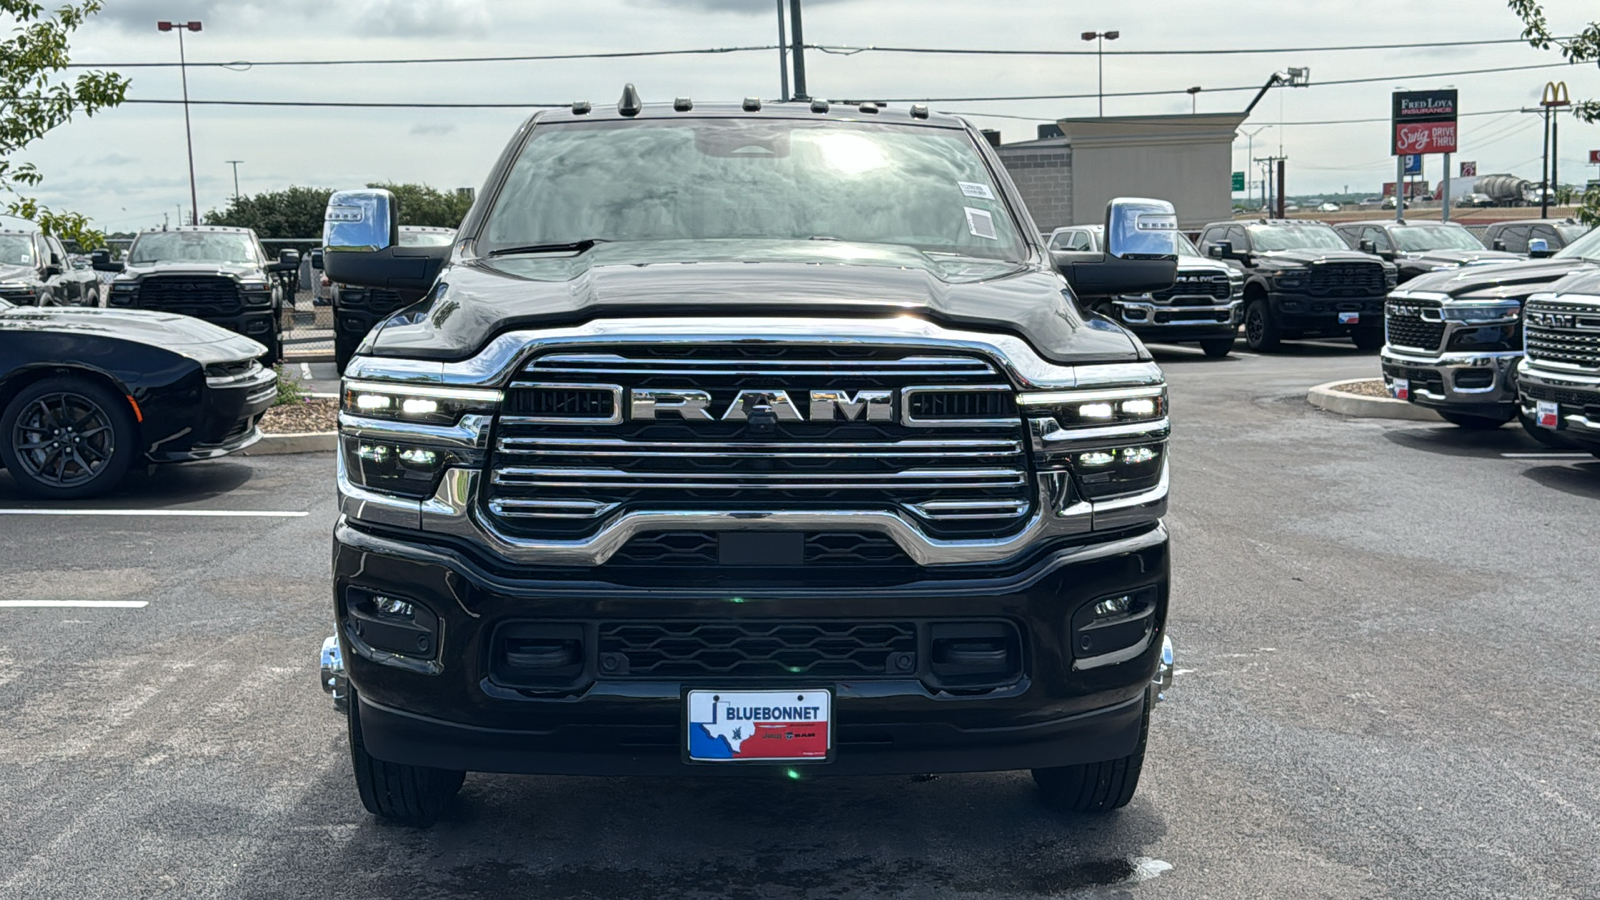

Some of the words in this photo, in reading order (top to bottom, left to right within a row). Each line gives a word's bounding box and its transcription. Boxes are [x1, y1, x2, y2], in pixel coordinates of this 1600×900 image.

[1401, 99, 1426, 109] FRED
[1427, 98, 1453, 108] LOYA
[1401, 107, 1453, 115] INSURANCE
[1432, 127, 1455, 136] DRIVE
[1397, 128, 1430, 149] Swig
[1432, 137, 1455, 147] THRU
[1531, 313, 1573, 327] RAM
[631, 389, 893, 421] RAM
[726, 707, 820, 720] BLUEBONNET
